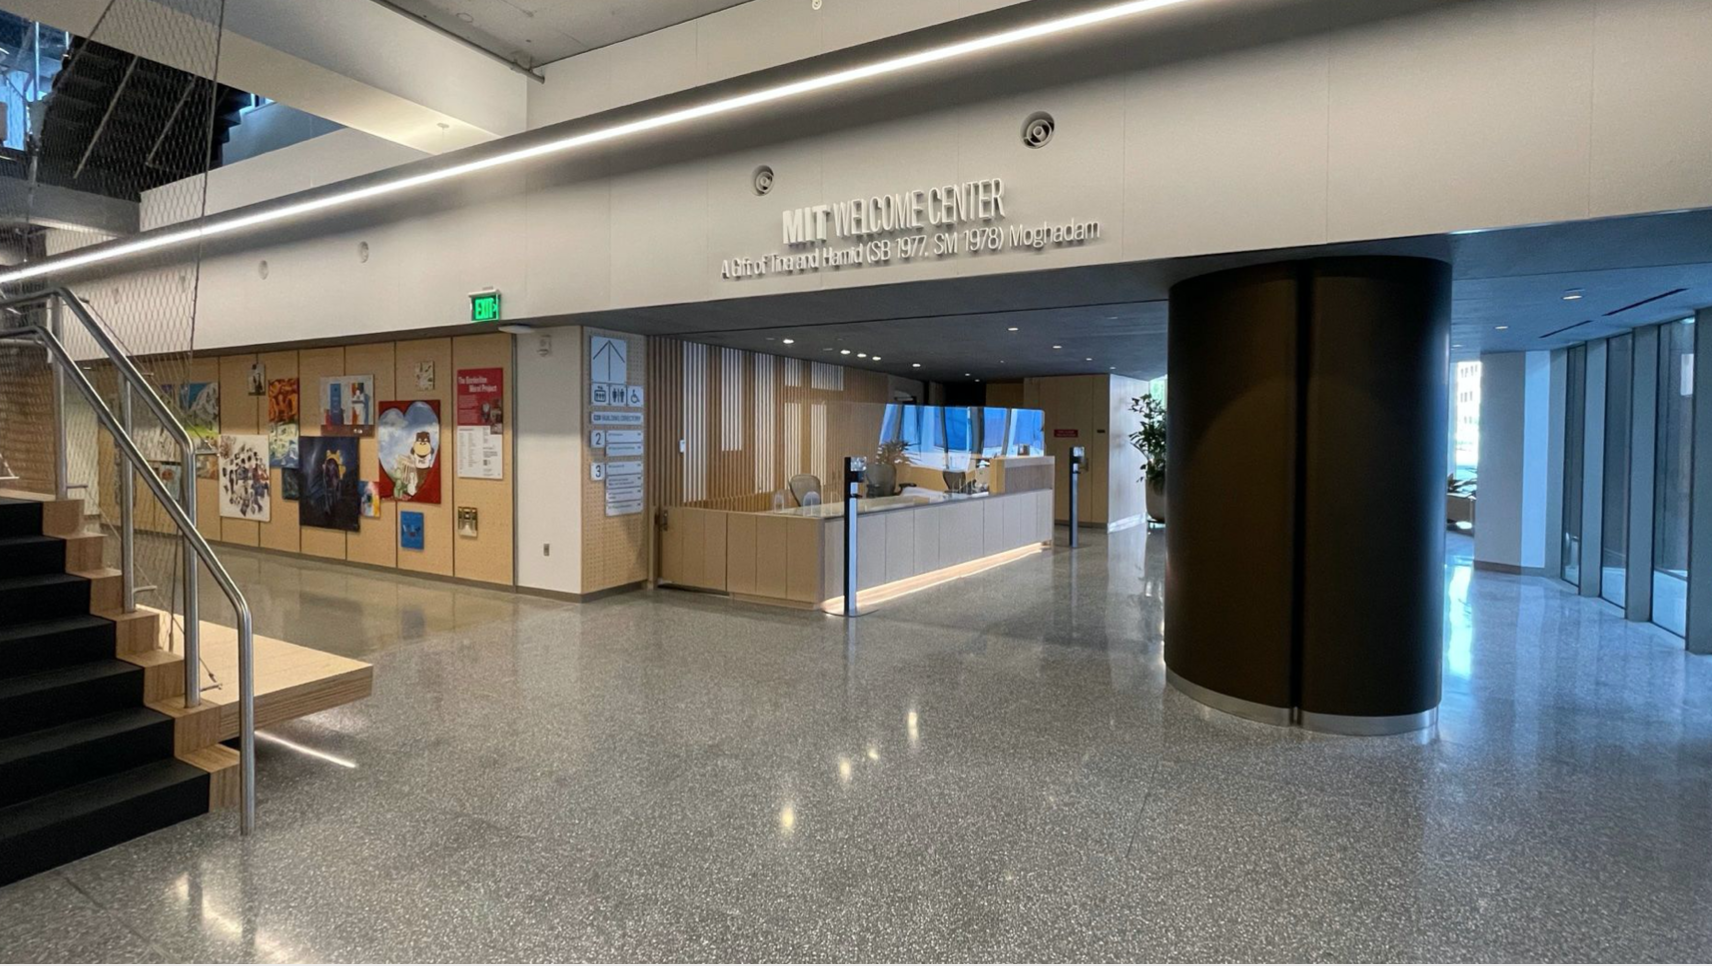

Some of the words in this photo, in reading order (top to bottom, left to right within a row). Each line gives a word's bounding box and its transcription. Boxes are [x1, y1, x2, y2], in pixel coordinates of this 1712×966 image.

[783, 205, 829, 244] MIT
[833, 190, 924, 237] WELCOME
[928, 178, 1005, 225] CENTER
[721, 259, 730, 278] A
[732, 257, 751, 277] Gift
[754, 255, 768, 274] of
[771, 253, 793, 272] Tina
[796, 248, 819, 270] and
[823, 243, 863, 267] Hamid
[866, 239, 891, 263] (SB
[934, 232, 958, 255] SM
[963, 227, 1005, 251] 1978)
[1009, 218, 1100, 248] Moghadam
[475, 297, 494, 320] EXIT
[482, 384, 497, 393] Project
[595, 432, 602, 446] 2
[595, 464, 602, 478] 3
